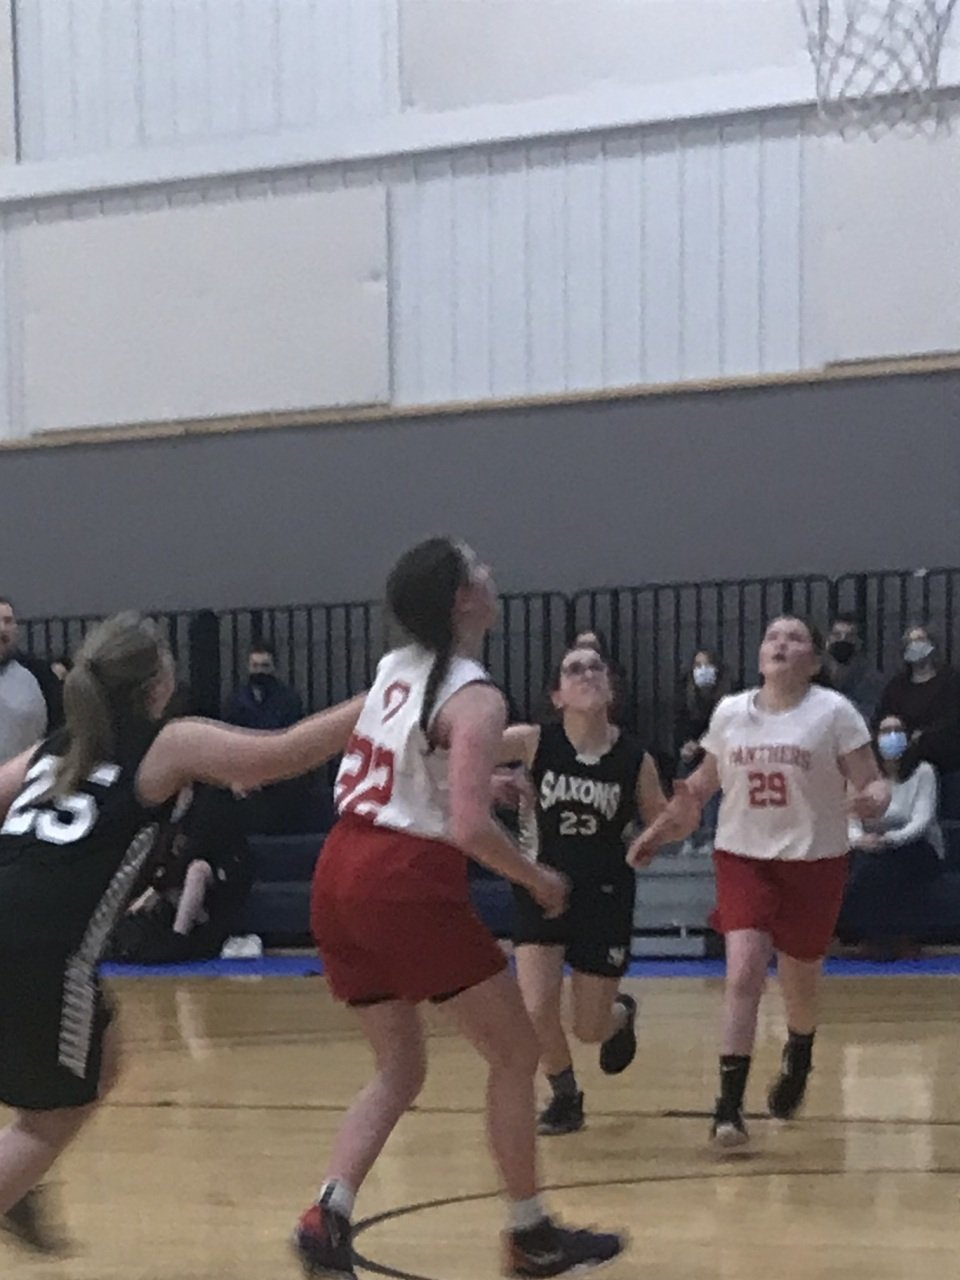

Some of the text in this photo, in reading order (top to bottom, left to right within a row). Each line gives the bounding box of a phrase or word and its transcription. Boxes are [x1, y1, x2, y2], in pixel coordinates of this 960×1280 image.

[540, 770, 620, 820] SAXONS
[748, 772, 787, 807] 29
[560, 811, 597, 835] 23
